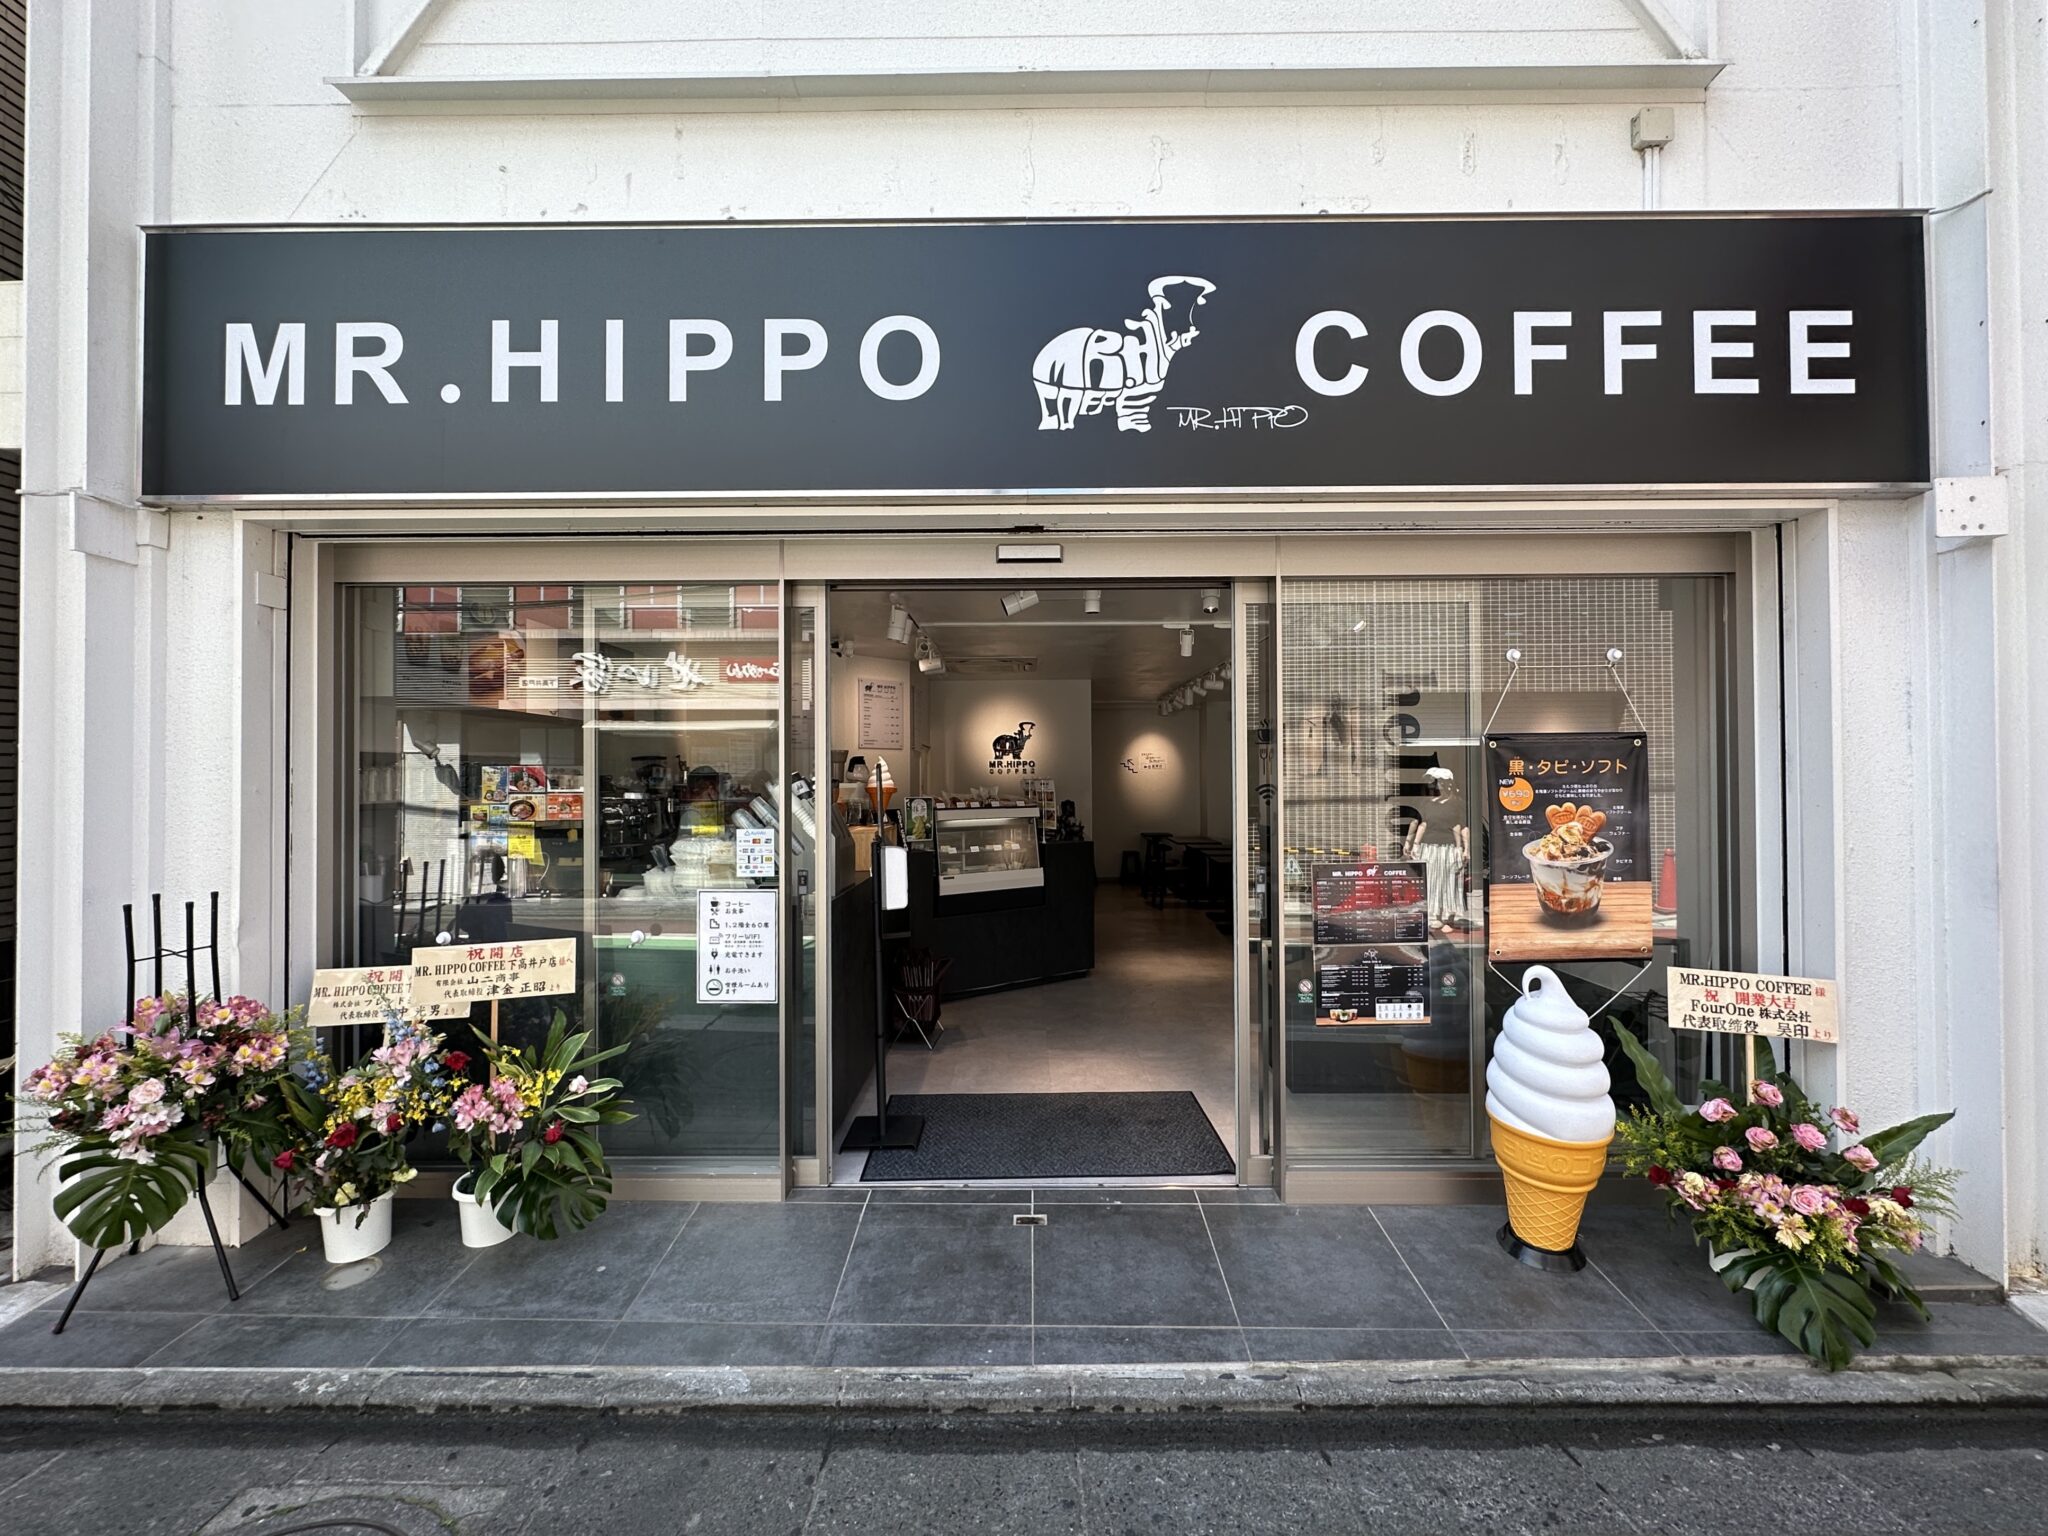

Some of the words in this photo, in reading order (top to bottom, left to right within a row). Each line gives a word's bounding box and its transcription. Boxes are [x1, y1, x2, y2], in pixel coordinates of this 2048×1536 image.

[1294, 309, 1858, 397] COFFEE
[989, 760, 1036, 768] MR.HIPPO
[1508, 759, 1628, 776] 黒・タピ・ソフト
[466, 945, 524, 960] 祝開店
[415, 966, 432, 977] MR.
[435, 963, 467, 975] HIPPO
[469, 960, 506, 973] COFFEE
[313, 987, 331, 998] MR.
[334, 985, 366, 997] HIPPO
[549, 983, 561, 992] より
[1680, 972, 1750, 991] MR.HIPPO
[1756, 979, 1812, 996] COFFEE
[1815, 986, 1826, 997] 様
[1704, 988, 1719, 1003] 祝
[1735, 991, 1796, 1010] 開業大吉
[340, 1009, 379, 1020] 代表取締役
[444, 1008, 455, 1016] より
[1691, 999, 1755, 1017] FourOne
[1759, 1007, 1812, 1023] 株式会社
[1683, 1014, 1759, 1034] 代表取締役
[1812, 1029, 1832, 1039] より
